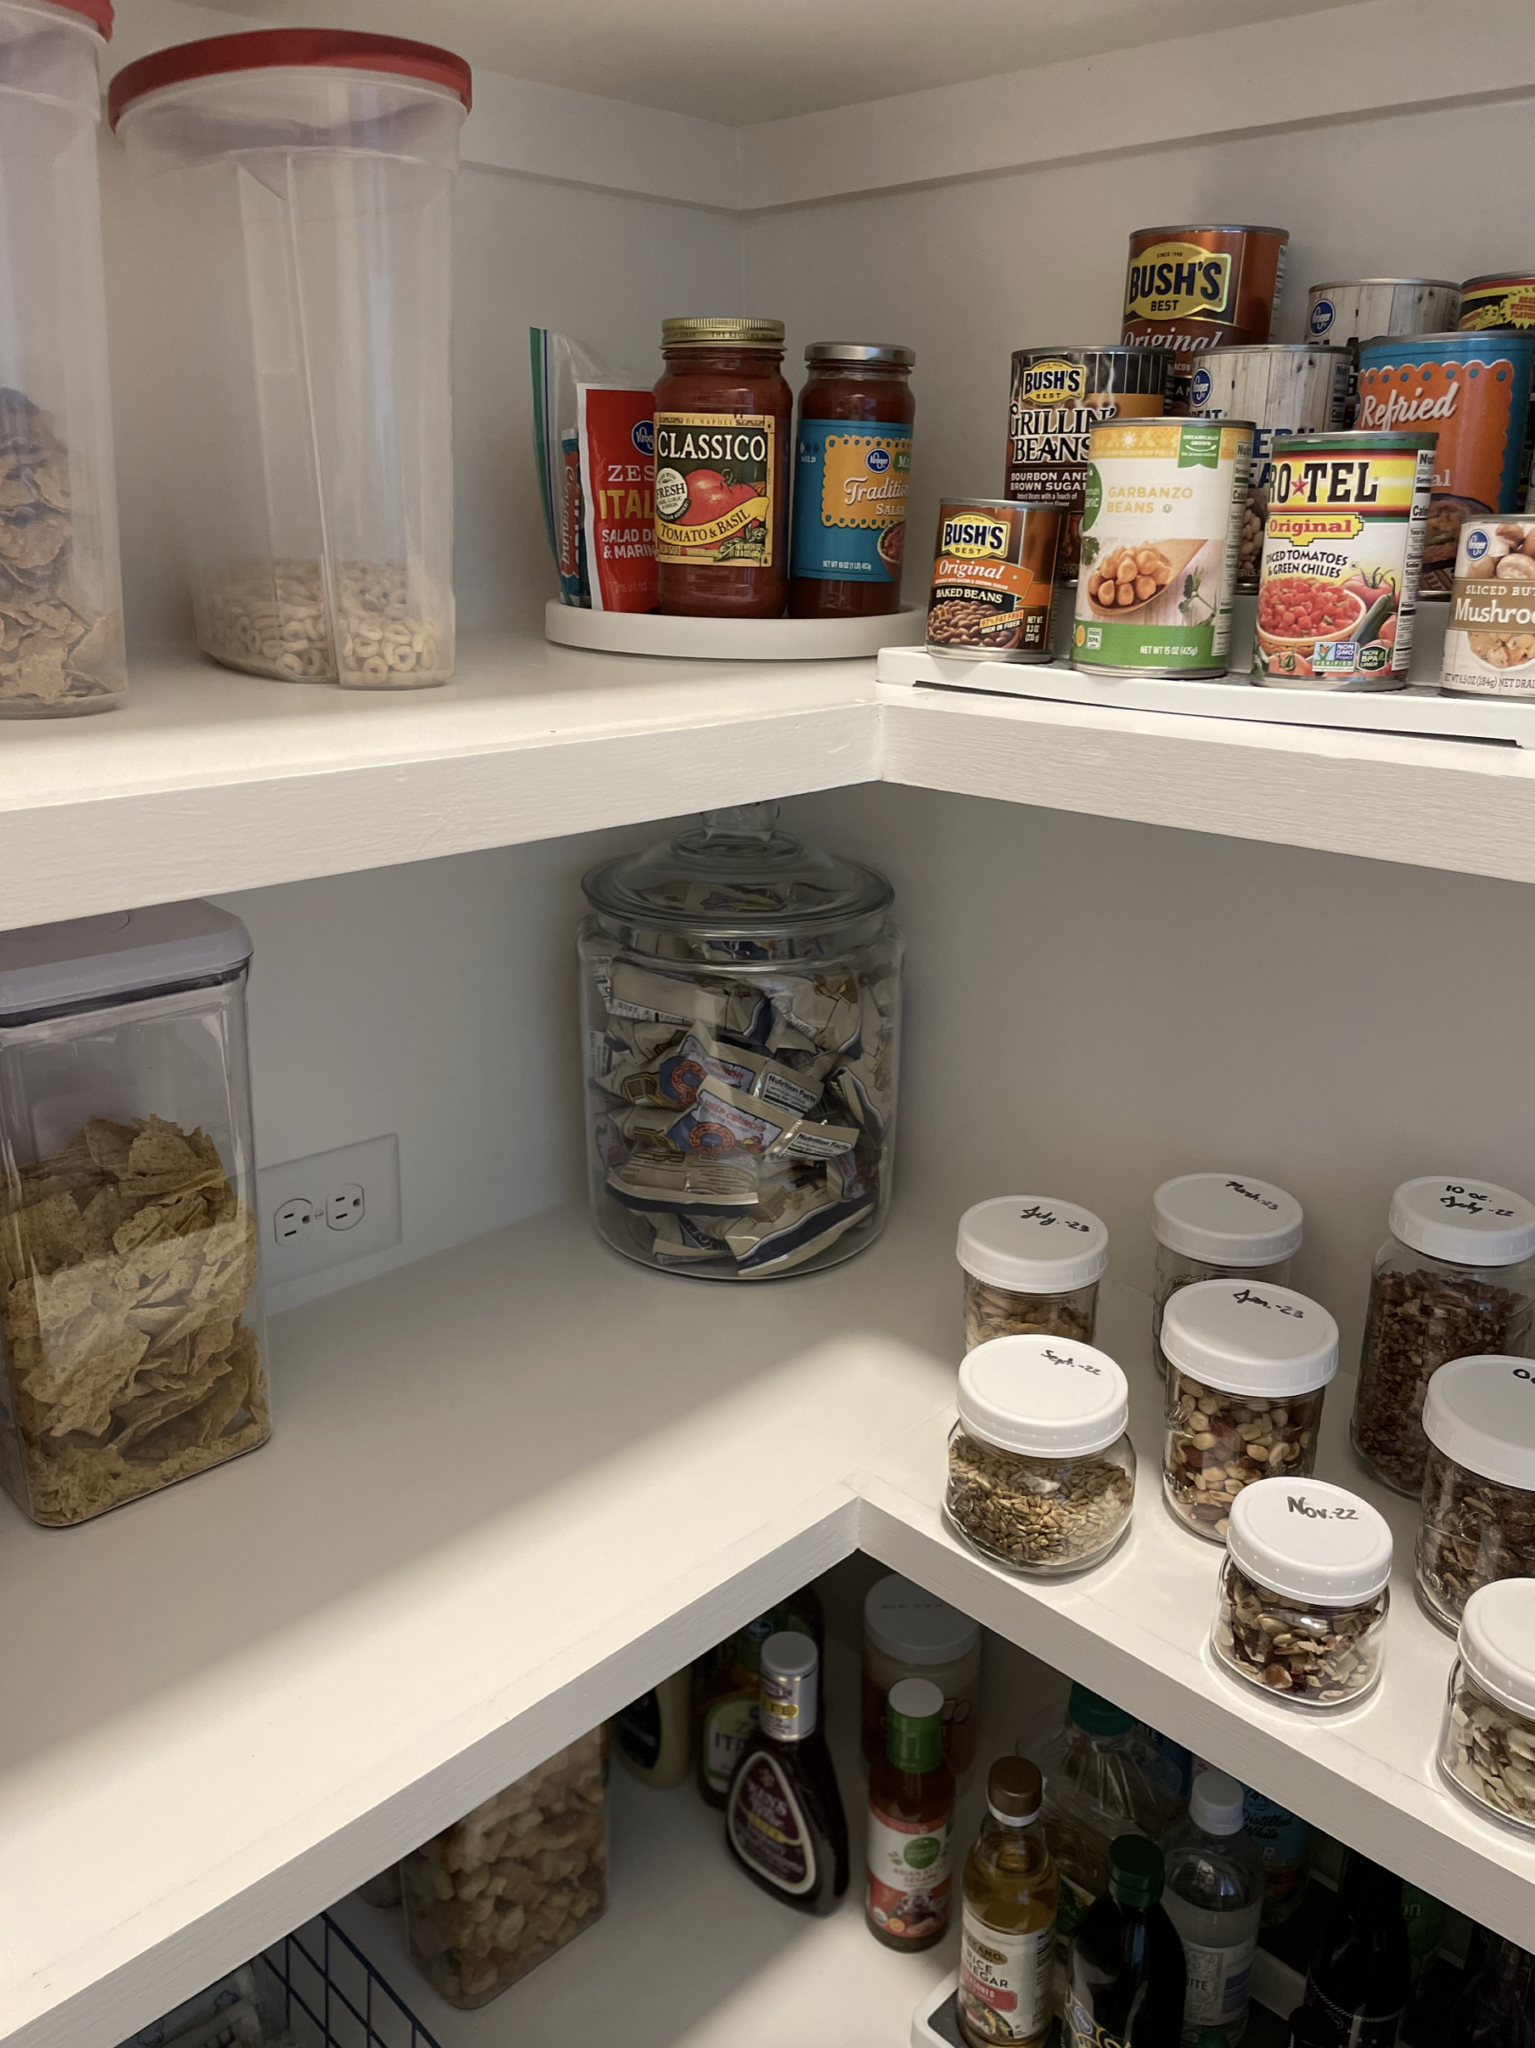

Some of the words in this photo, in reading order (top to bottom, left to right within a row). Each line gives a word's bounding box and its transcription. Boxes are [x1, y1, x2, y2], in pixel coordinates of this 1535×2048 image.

[1129, 261, 1222, 305] BUSH'S
[1151, 300, 1180, 312] BEST
[1024, 370, 1080, 395] BUSH'S
[1036, 392, 1061, 400] BEST
[1361, 381, 1459, 431] Refried
[1010, 403, 1116, 438] GRILLIN'
[658, 430, 766, 461] CLASSICO
[1013, 437, 1090, 462] BEANS
[869, 452, 889, 469] Kroger
[608, 465, 654, 482] ZES
[1011, 472, 1057, 481] BOURBON
[656, 482, 686, 500] FRESH
[1010, 482, 1042, 490] BROWN
[1108, 486, 1193, 499] GARBANZO
[599, 489, 654, 519] ITAL
[1107, 502, 1154, 514] BEANS
[661, 524, 708, 542] TOMATO
[709, 528, 718, 538] &
[715, 509, 751, 535] BASIL
[1269, 519, 1352, 537] Original
[602, 529, 639, 543] SALAD
[944, 523, 1004, 550] BUSH'S
[604, 547, 613, 559] &
[615, 546, 655, 558] MARIN
[955, 547, 982, 555] BEST
[1287, 549, 1349, 567] TOMATOES
[939, 560, 1006, 580] Original
[1273, 562, 1300, 575] GREEN
[1301, 563, 1342, 579] CHILIES
[936, 588, 963, 598] BAKED
[964, 589, 1003, 604] BEANS
[1465, 585, 1507, 596] SLICED
[1512, 586, 1535, 597] BUT
[995, 614, 1007, 624] FAT
[1008, 610, 1024, 621] FREE
[1454, 598, 1535, 625] Mushro
[1004, 620, 1020, 630] FIBER
[1140, 646, 1152, 654] NET
[1153, 646, 1164, 655] WT
[1164, 646, 1170, 655] 15
[1171, 647, 1180, 655] OZ
[1467, 675, 1476, 685] OZ
[1476, 675, 1498, 689] (184g)
[1499, 678, 1514, 688] NET
[768, 1074, 799, 1094] Nutrition
[799, 1088, 817, 1103] Facts
[798, 1133, 830, 1147] Nutrition
[829, 1142, 850, 1152] Facts
[1445, 1185, 1465, 1194] 10
[1440, 1195, 1483, 1215] July
[967, 1948, 993, 1975] RICE
